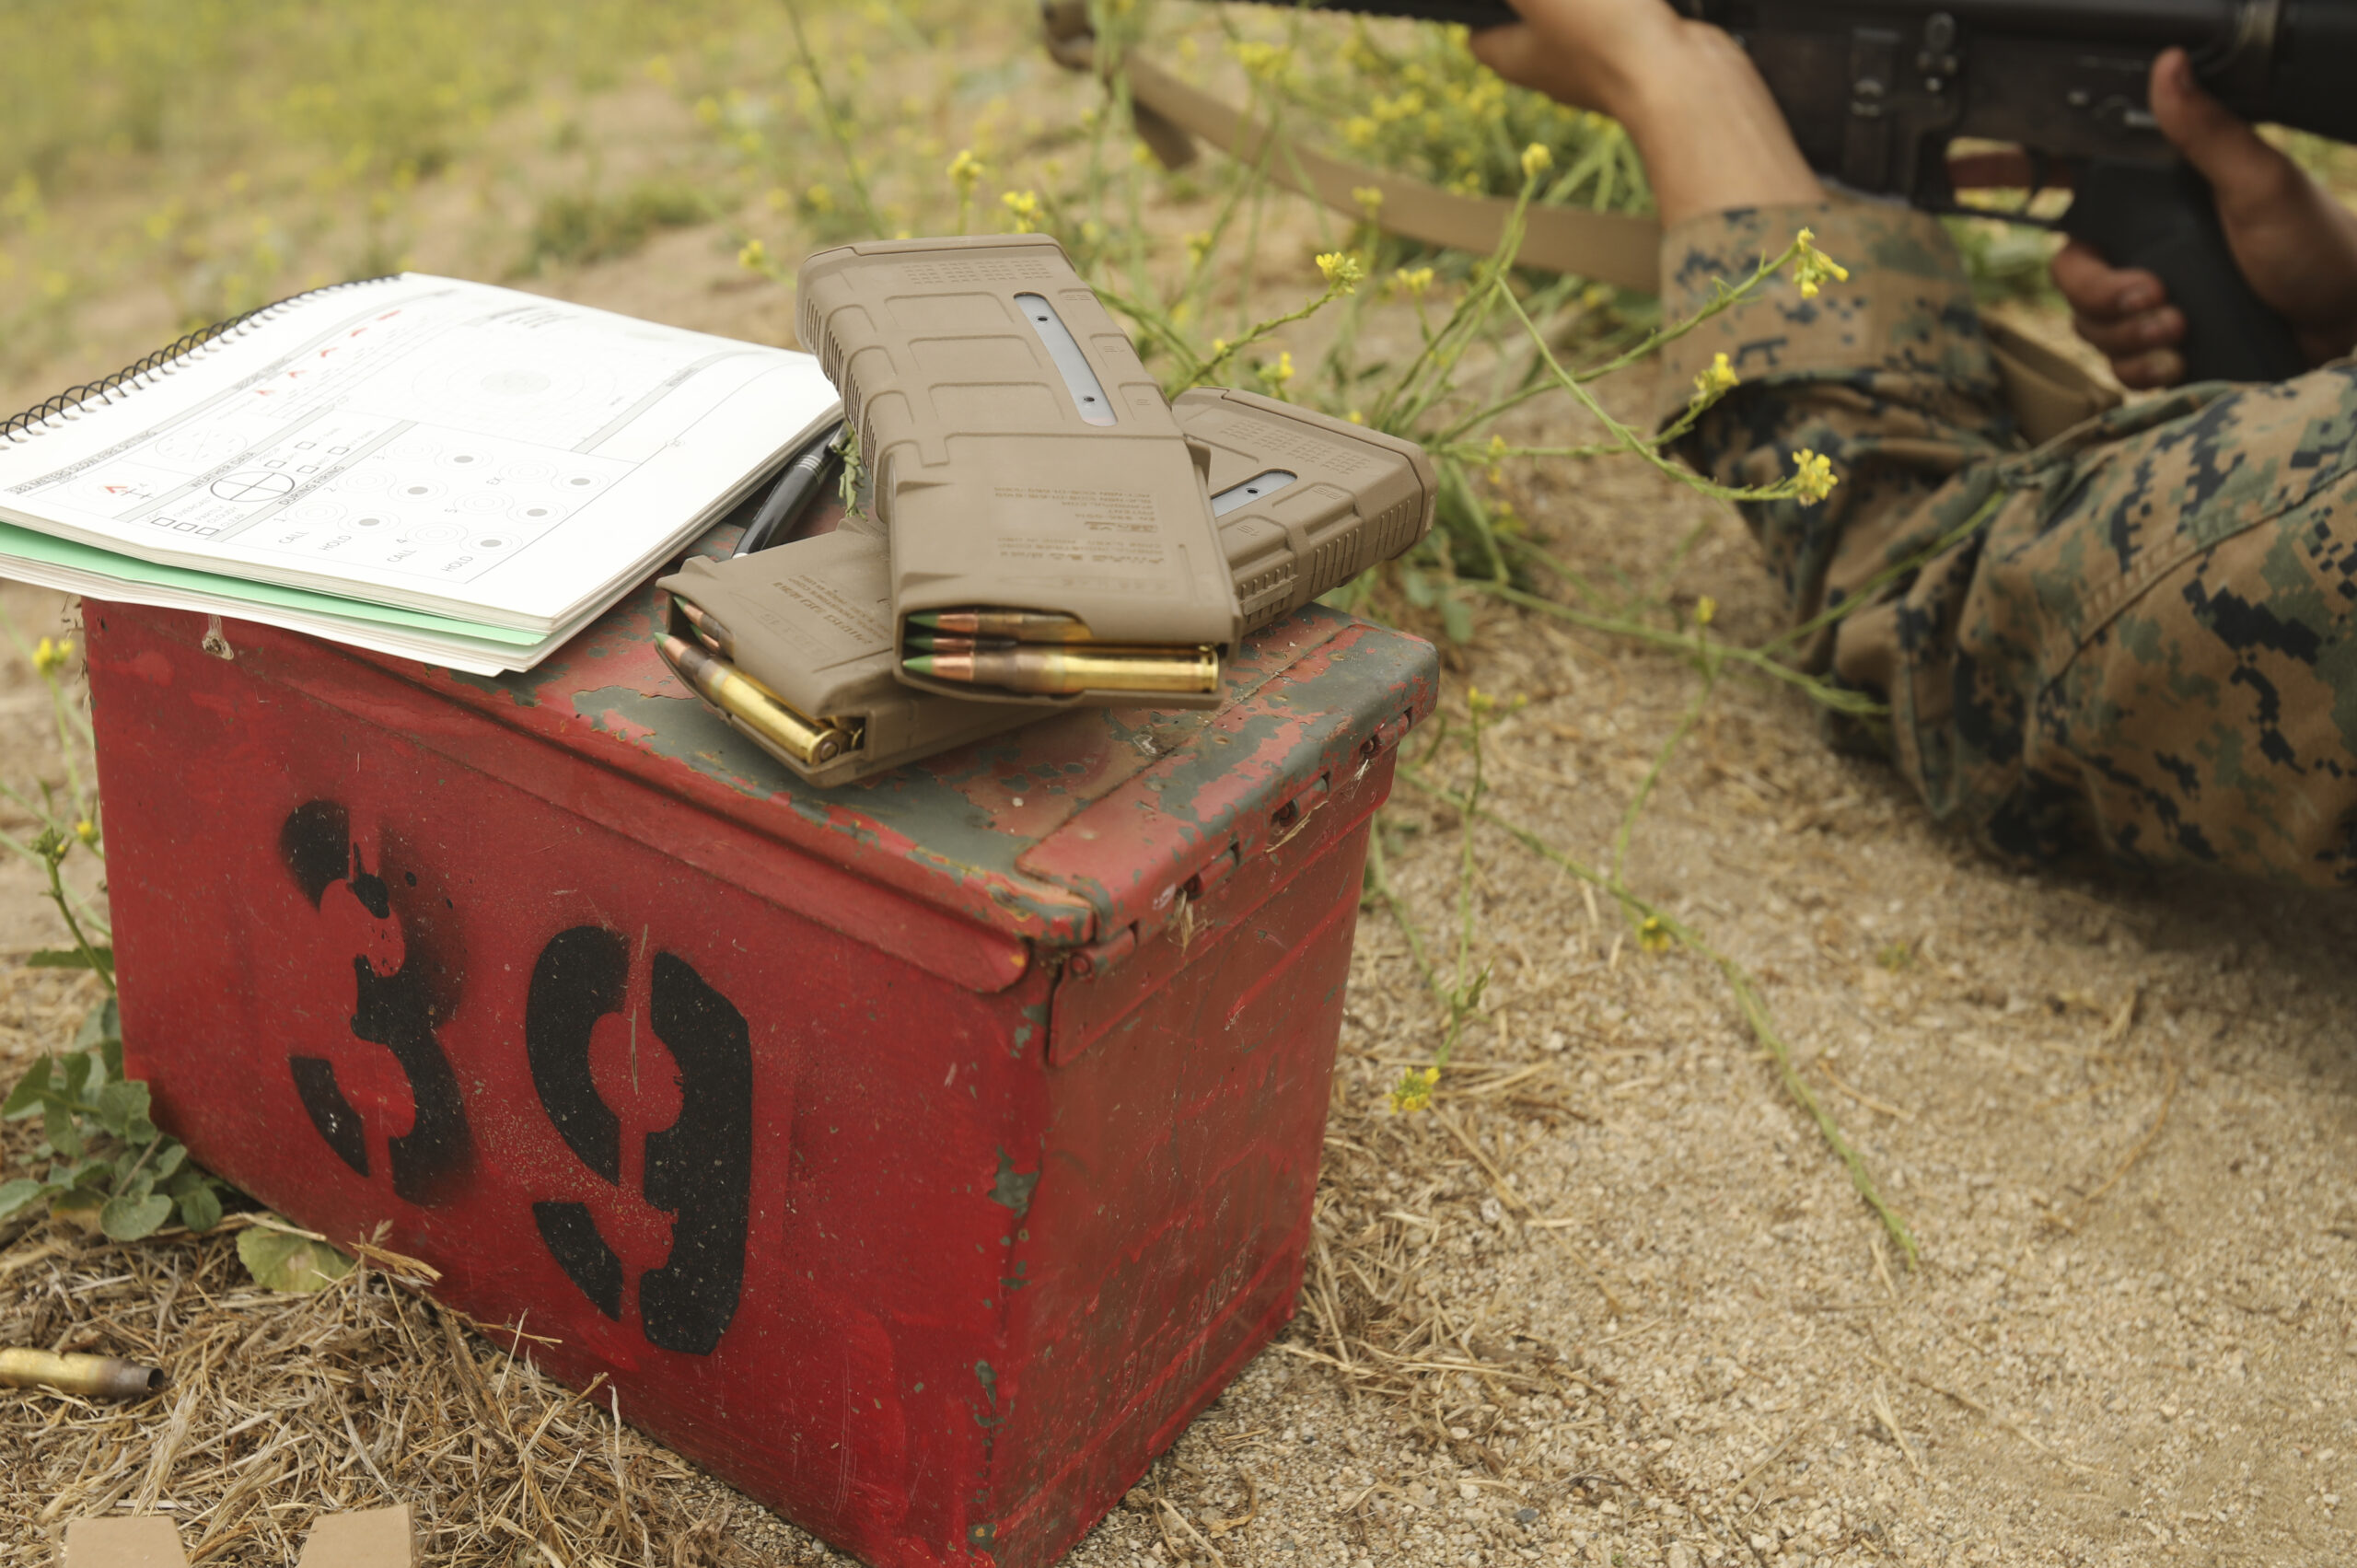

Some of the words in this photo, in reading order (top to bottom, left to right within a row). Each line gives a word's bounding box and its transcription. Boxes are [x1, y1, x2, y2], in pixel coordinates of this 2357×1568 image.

[189, 464, 231, 488] WEATHER
[230, 451, 255, 466] DATA
[278, 482, 318, 506] DURING
[314, 465, 345, 486] FIRING
[486, 476, 505, 486] EX
[278, 530, 311, 545] CALL
[318, 533, 353, 552] HOLD
[386, 549, 418, 563] CALL
[441, 554, 474, 574] HOLD
[279, 799, 752, 1355] 39
